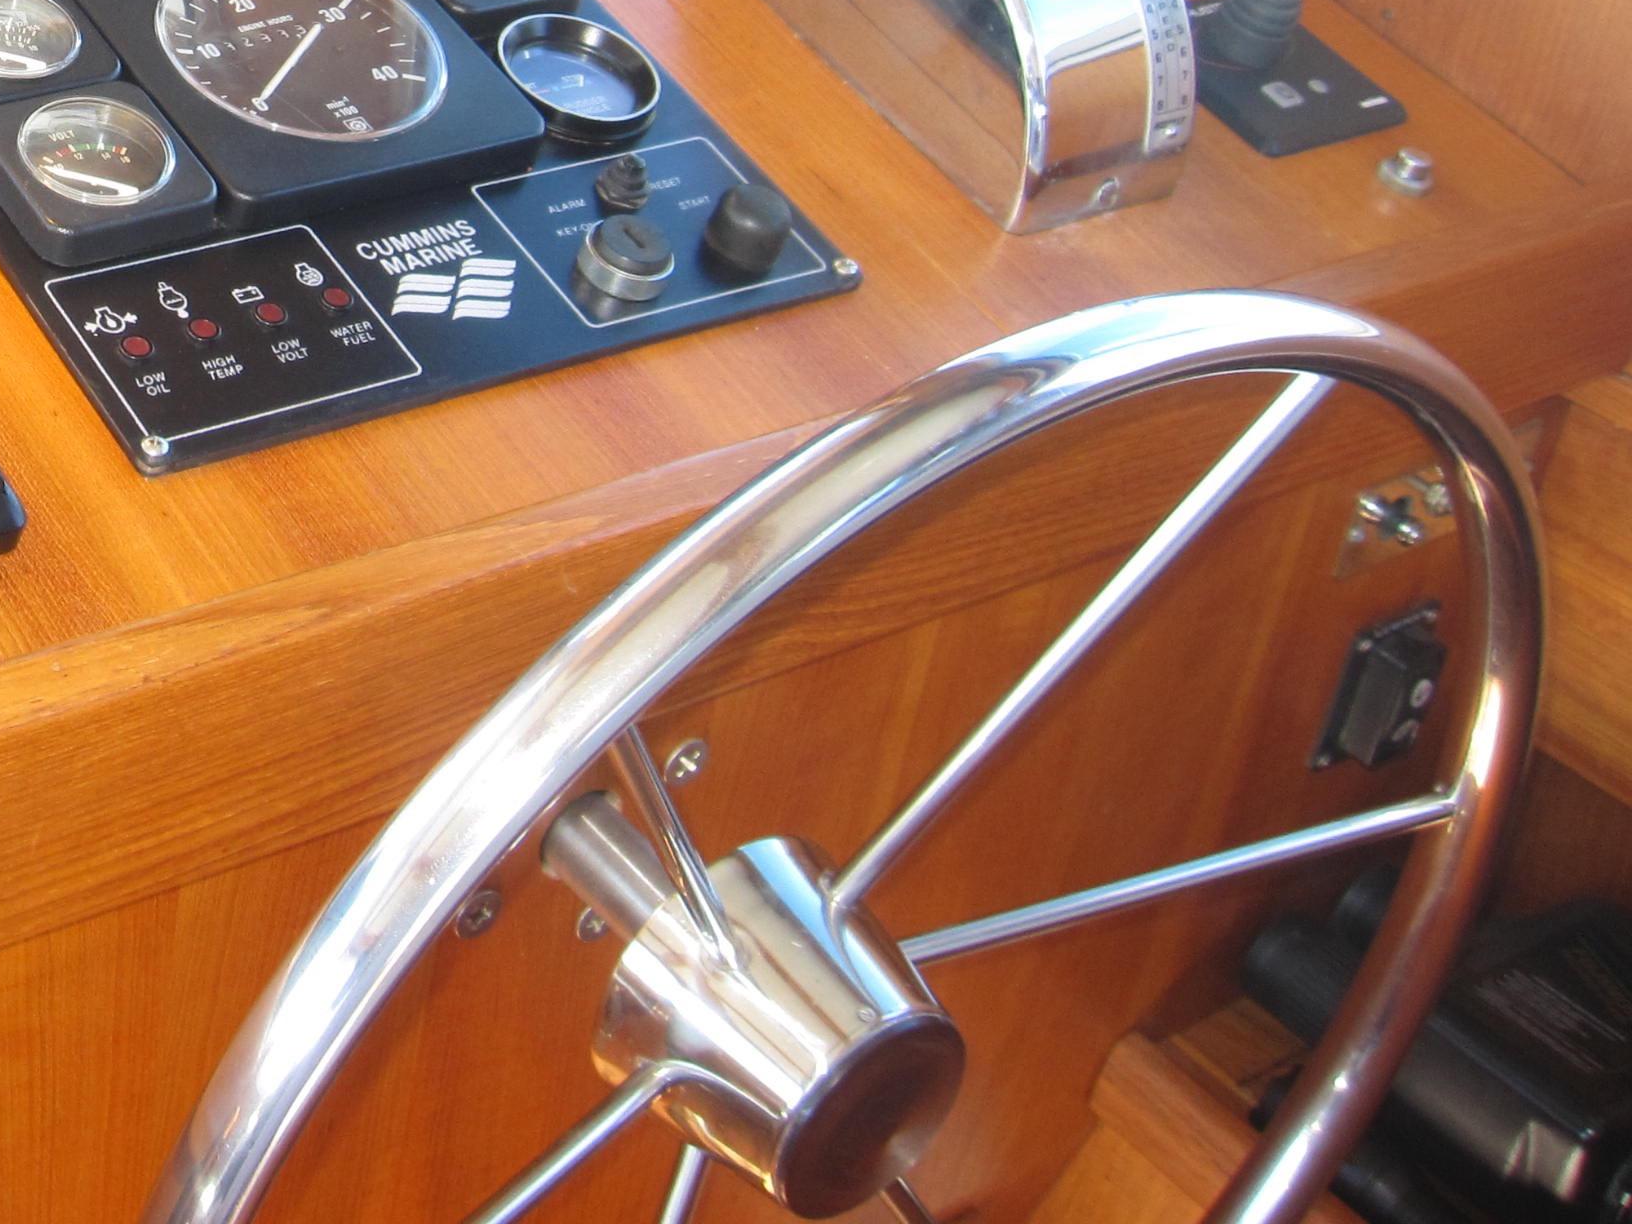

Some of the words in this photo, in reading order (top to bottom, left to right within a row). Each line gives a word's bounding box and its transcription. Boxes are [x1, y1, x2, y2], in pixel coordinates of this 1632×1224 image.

[318, 6, 347, 24] 30
[196, 42, 222, 60] 10
[370, 65, 400, 83] 40
[48, 129, 76, 143] VOLT
[547, 197, 588, 214] ALARM
[354, 218, 478, 263] CUMMINS
[378, 239, 484, 277] MARINE
[328, 320, 374, 339] WATER
[270, 337, 302, 354] LOW
[342, 330, 377, 347] FUEL
[201, 353, 236, 370] HIGH
[275, 347, 310, 364] VOLT
[135, 371, 166, 388] LOW
[207, 363, 245, 381] TEMP
[145, 384, 172, 397] OIL
